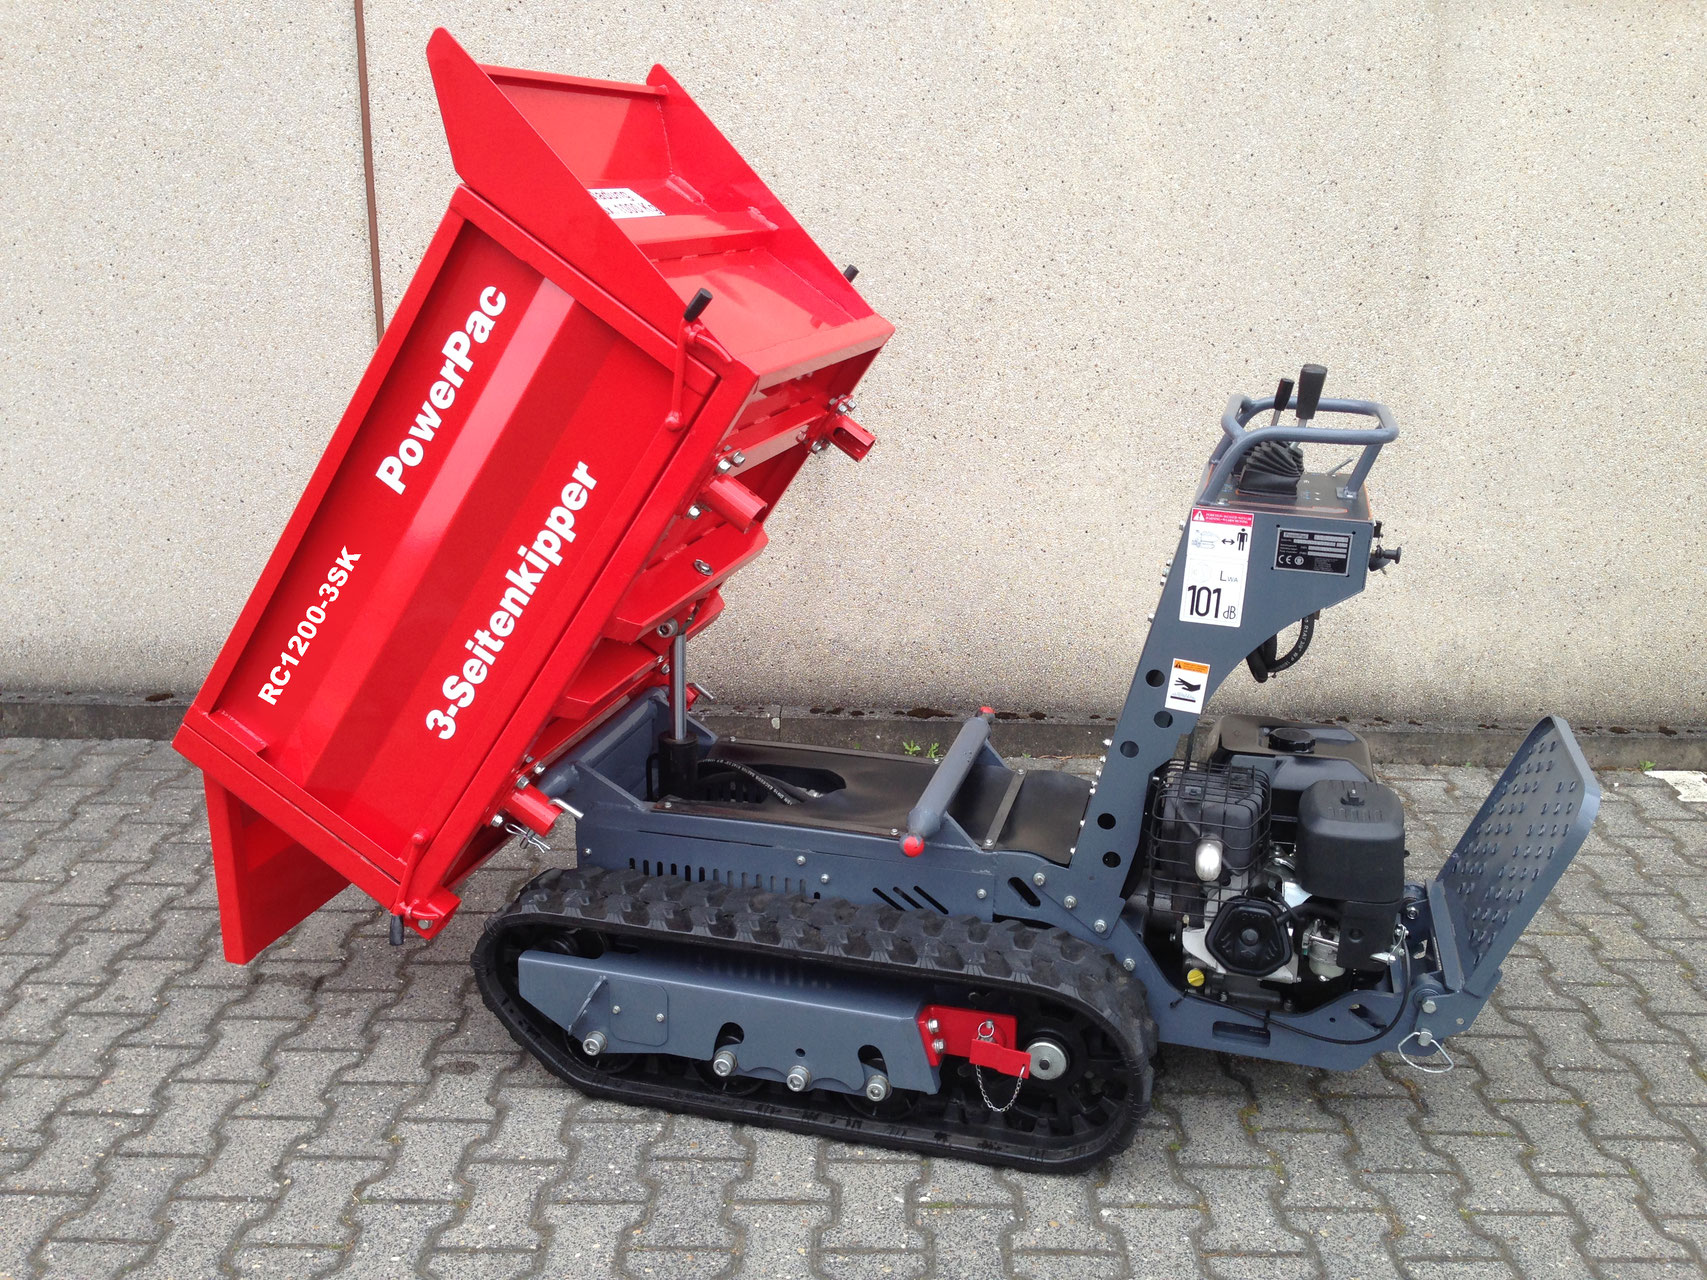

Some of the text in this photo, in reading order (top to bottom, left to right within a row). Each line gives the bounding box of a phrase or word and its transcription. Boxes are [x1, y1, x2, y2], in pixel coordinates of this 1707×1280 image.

[613, 203, 644, 213] 1000
[375, 286, 507, 495] PowerPac
[257, 545, 361, 705] RC1200-3SK
[425, 461, 598, 740] 3-Seitenkipper
[1187, 584, 1237, 619] 101 dB
